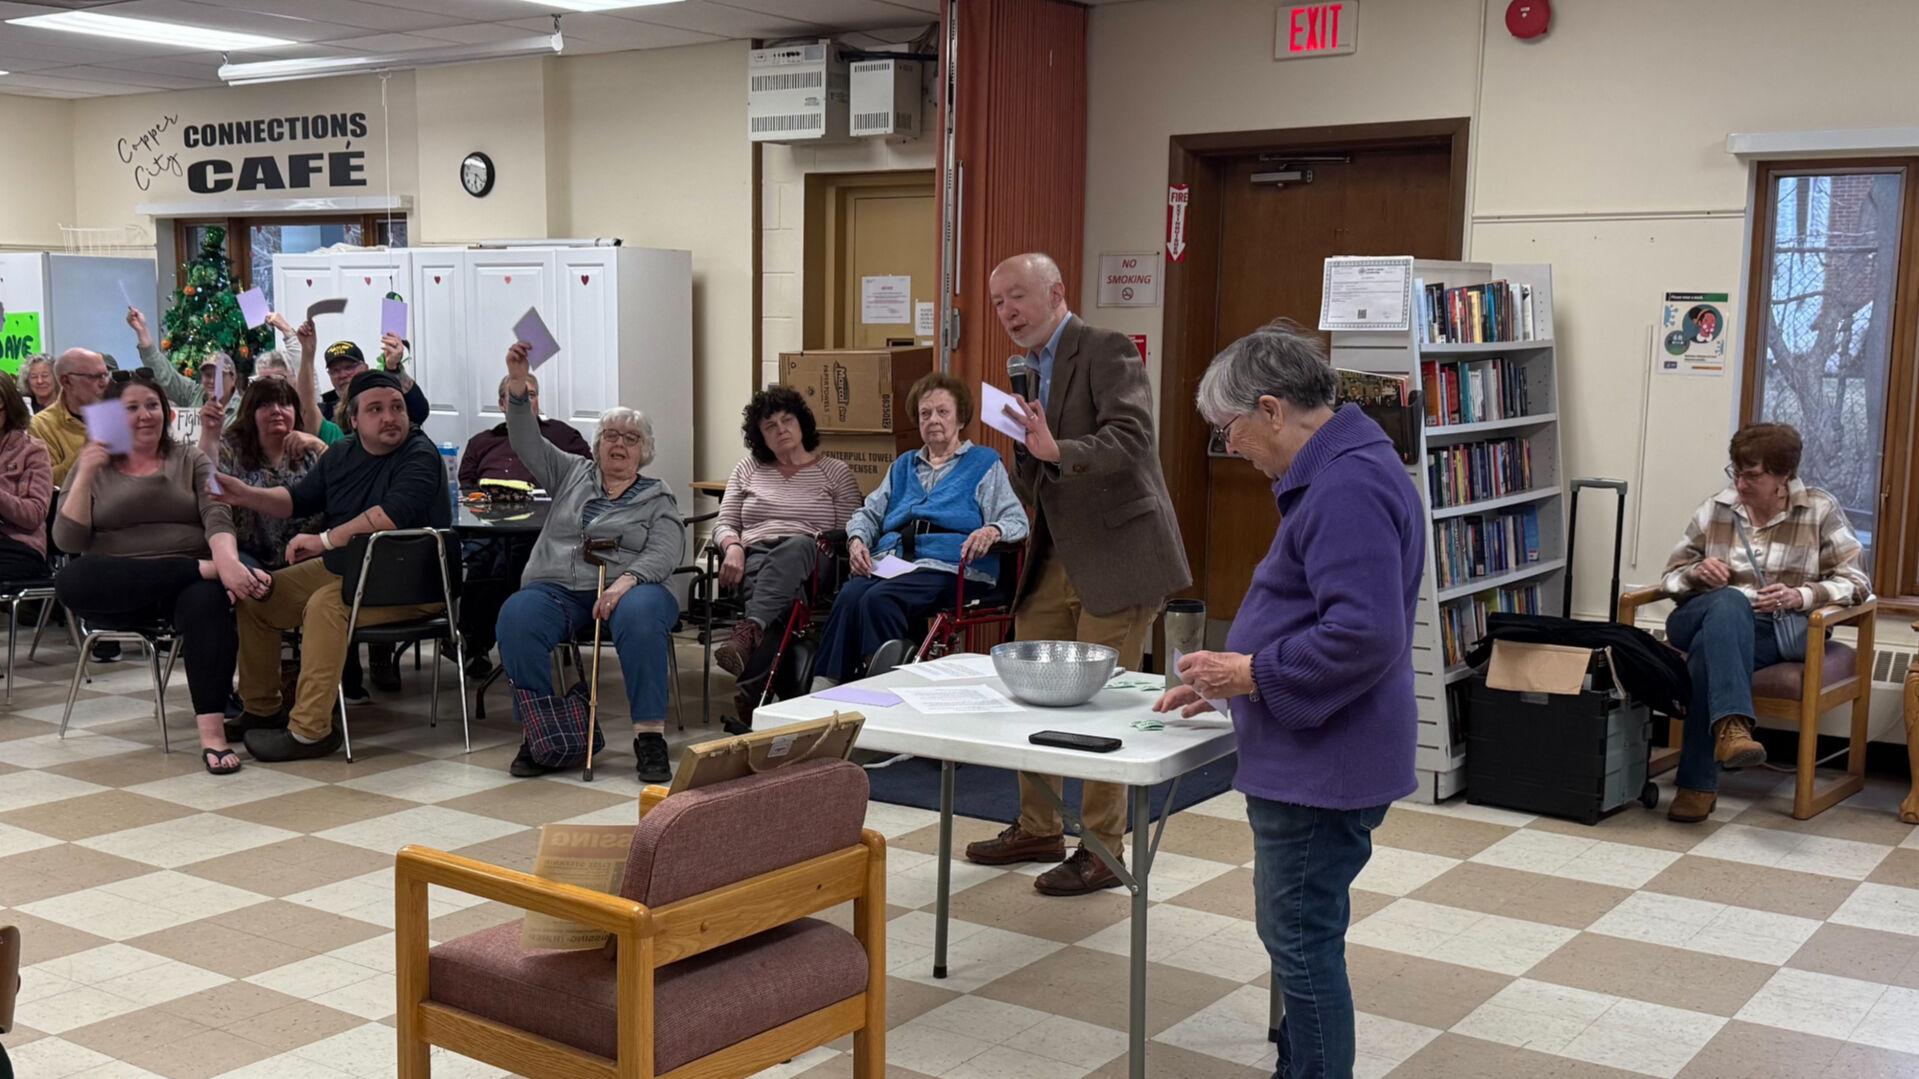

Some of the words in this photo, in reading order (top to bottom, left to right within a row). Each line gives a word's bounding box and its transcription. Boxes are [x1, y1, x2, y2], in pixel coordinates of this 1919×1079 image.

[1289, 4, 1343, 52] EXIT
[118, 113, 178, 164] Copper
[183, 112, 368, 149] CONNECTIONS
[134, 152, 184, 191] City
[187, 140, 368, 194] CAFÉ
[1171, 191, 1189, 204] FIRE
[1122, 258, 1136, 269] NO
[1106, 275, 1152, 285] SMOKING
[821, 451, 866, 462] CENTERPULL
[869, 452, 892, 463] TOWEL
[849, 464, 878, 474] PENSER
